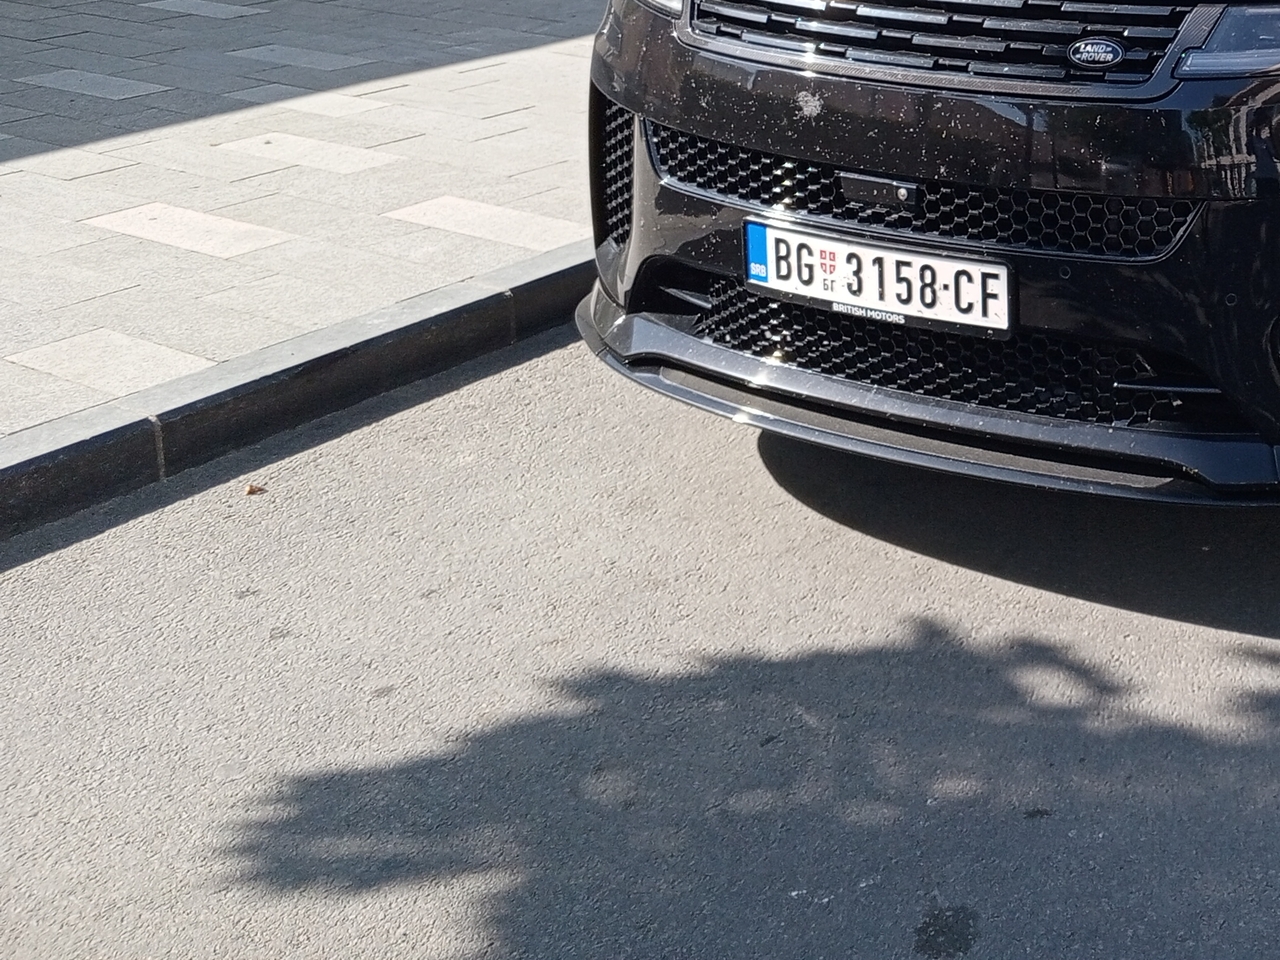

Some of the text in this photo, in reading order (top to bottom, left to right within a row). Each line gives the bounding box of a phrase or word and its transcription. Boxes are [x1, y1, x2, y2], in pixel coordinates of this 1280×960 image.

[750, 262, 767, 277] SRB
[774, 237, 814, 286] BG
[832, 302, 905, 324] BRITISH MOTORS
